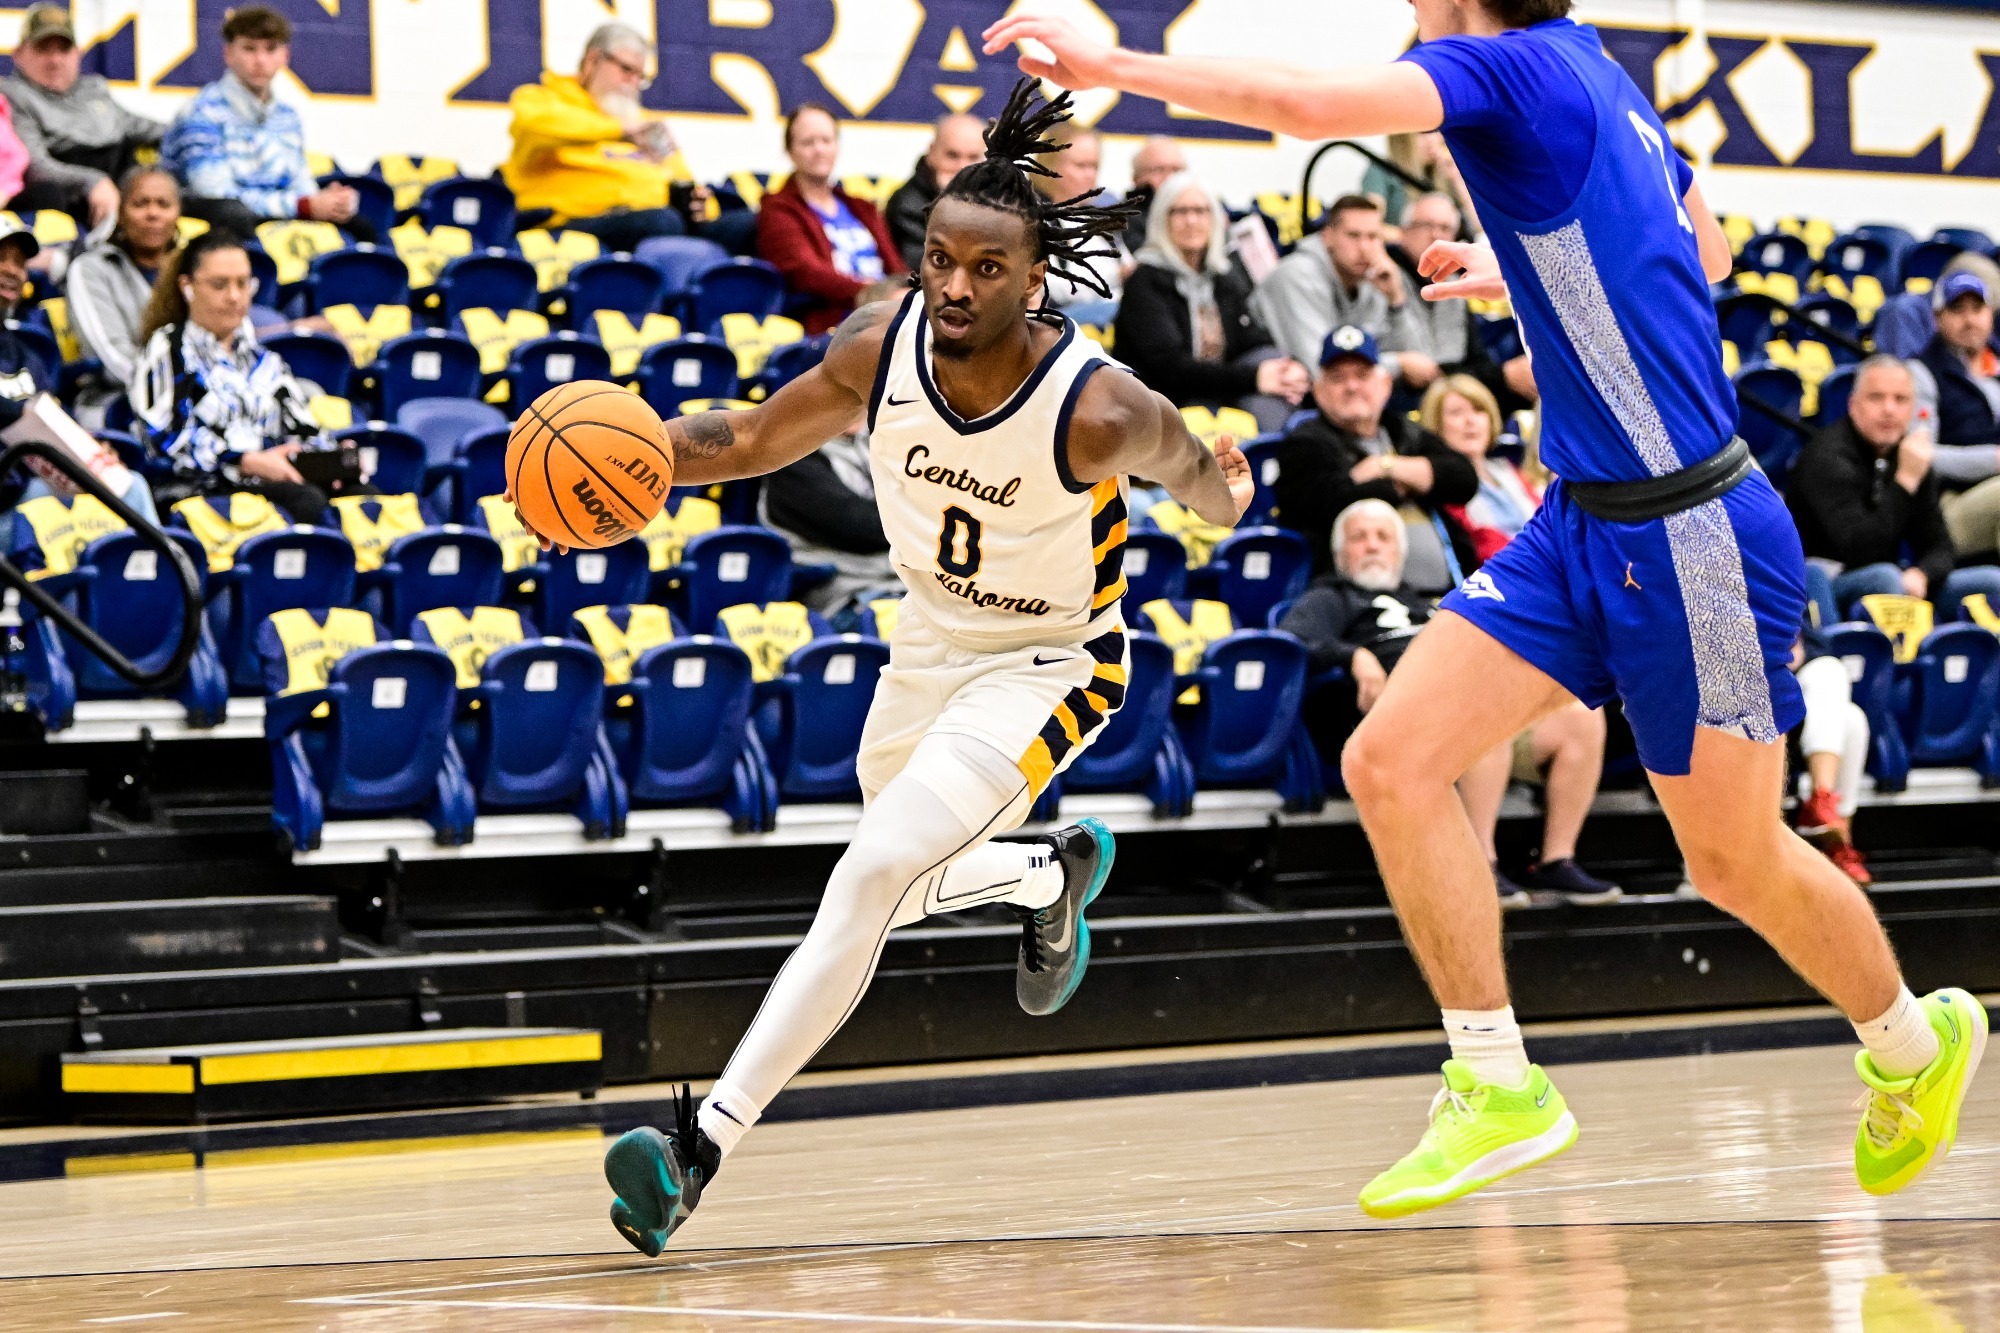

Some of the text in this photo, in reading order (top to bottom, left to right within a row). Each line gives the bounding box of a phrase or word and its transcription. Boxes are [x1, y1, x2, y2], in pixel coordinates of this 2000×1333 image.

[904, 444, 1022, 507] Central
[934, 503, 984, 580] 0
[901, 563, 1051, 616] ahoma
